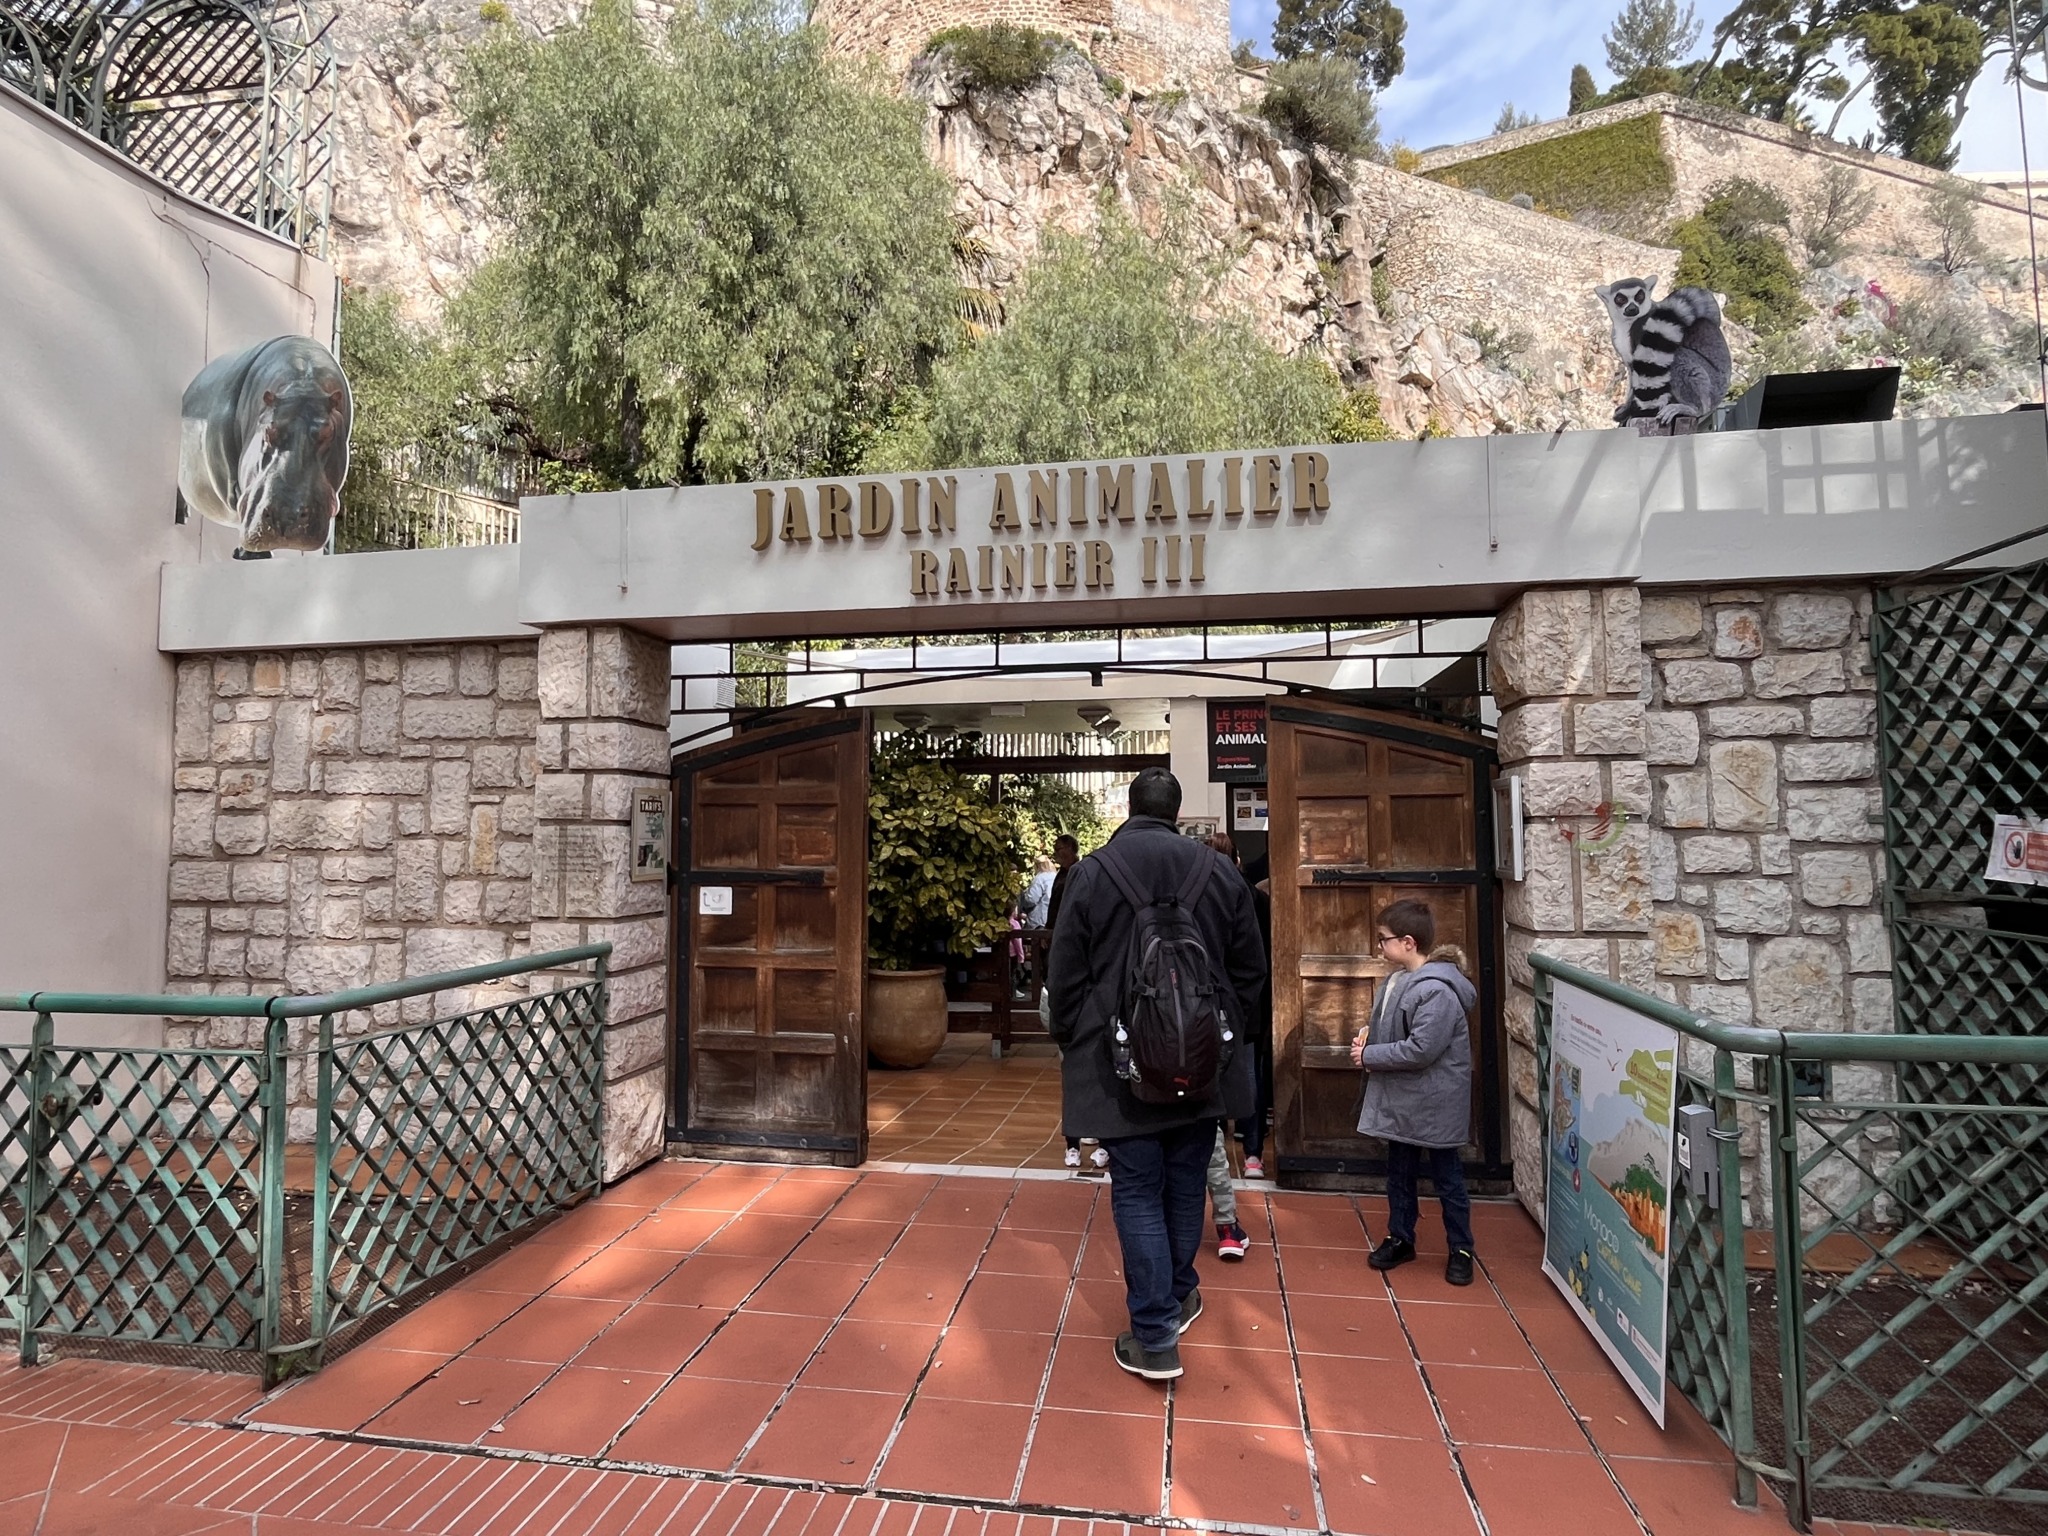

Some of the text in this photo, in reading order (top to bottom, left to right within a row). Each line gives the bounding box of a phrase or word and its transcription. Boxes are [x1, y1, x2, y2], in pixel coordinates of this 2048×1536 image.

[751, 452, 1331, 551] JARDIN ANIMALIER
[910, 534, 1206, 596] RAINIER III
[1215, 709, 1231, 721] LE
[1215, 721, 1257, 732] ET SES
[640, 801, 662, 812] TARIFS
